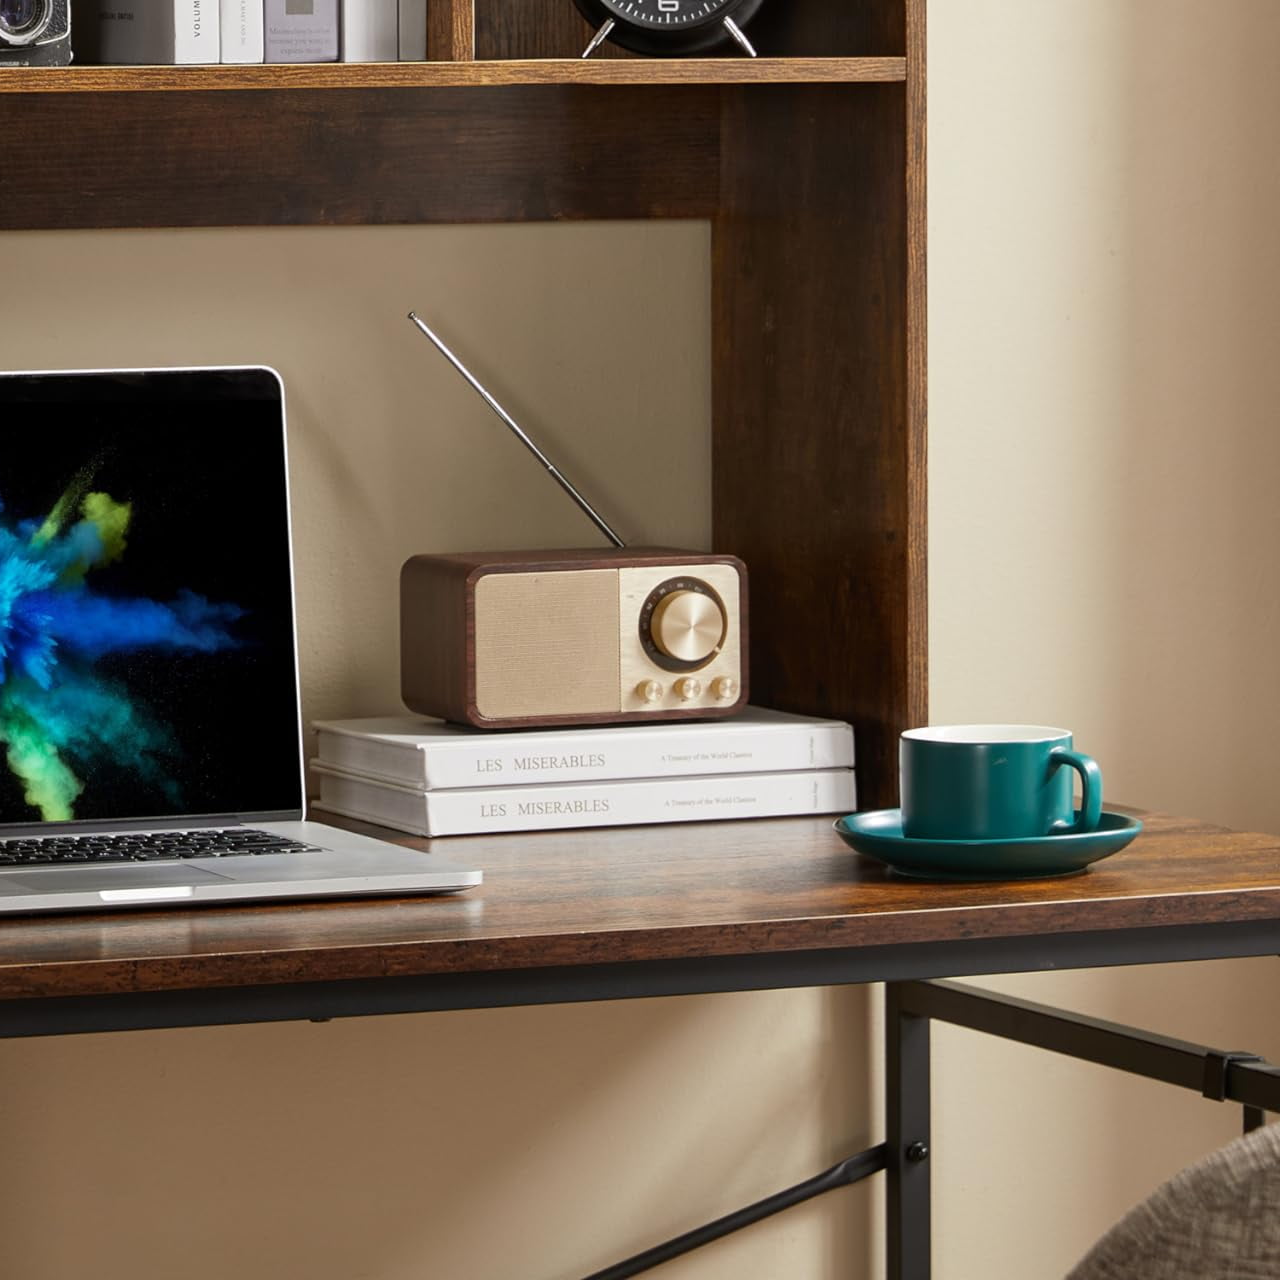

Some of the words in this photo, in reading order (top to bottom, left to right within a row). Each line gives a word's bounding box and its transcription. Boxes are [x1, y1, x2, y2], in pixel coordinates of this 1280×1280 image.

[476, 759, 503, 773] LES
[514, 754, 606, 771] MISERABLES
[480, 803, 507, 818] LES
[518, 799, 610, 816] MISERABLES
